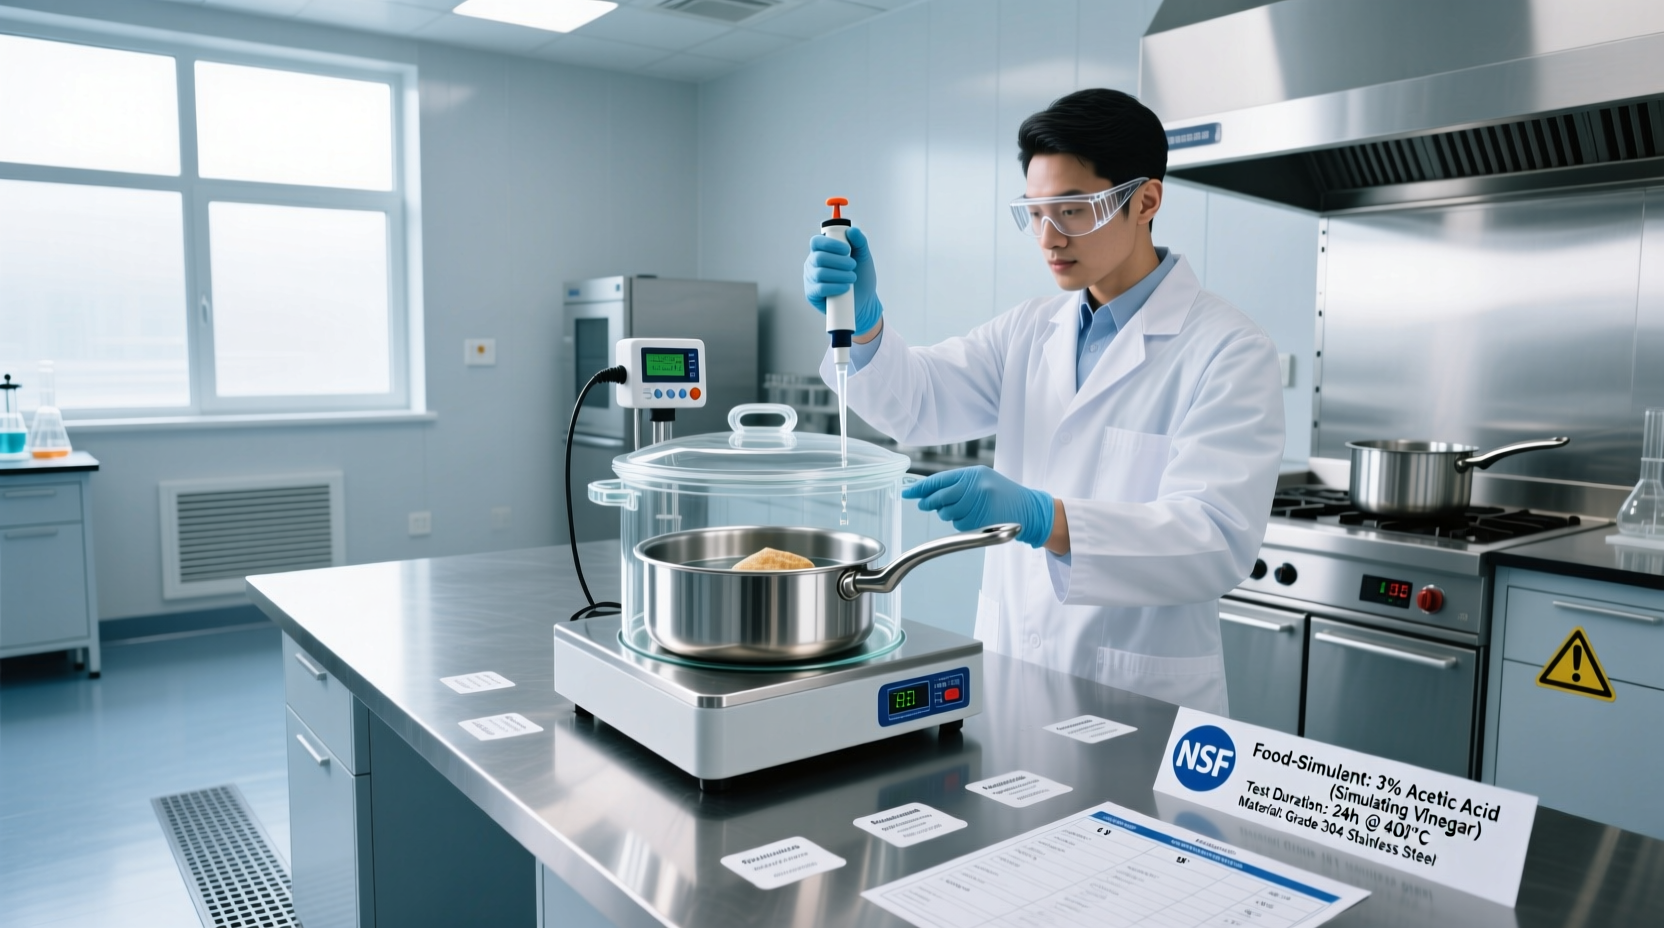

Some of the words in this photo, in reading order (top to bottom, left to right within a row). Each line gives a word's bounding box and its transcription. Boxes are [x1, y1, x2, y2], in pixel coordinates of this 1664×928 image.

[1175, 739, 1234, 777] NSF
[1253, 742, 1371, 787] Food-Simulent:
[1376, 774, 1401, 796] 3%
[1406, 784, 1457, 810] Acetic
[1459, 798, 1501, 822] Acid
[1246, 780, 1270, 798] Test
[1332, 804, 1359, 825] 24h
[1365, 814, 1381, 832] @
[1330, 783, 1408, 820] (Simulating
[1285, 810, 1319, 830] Grade
[1320, 819, 1344, 838] 304
[1402, 845, 1436, 867] Steel
